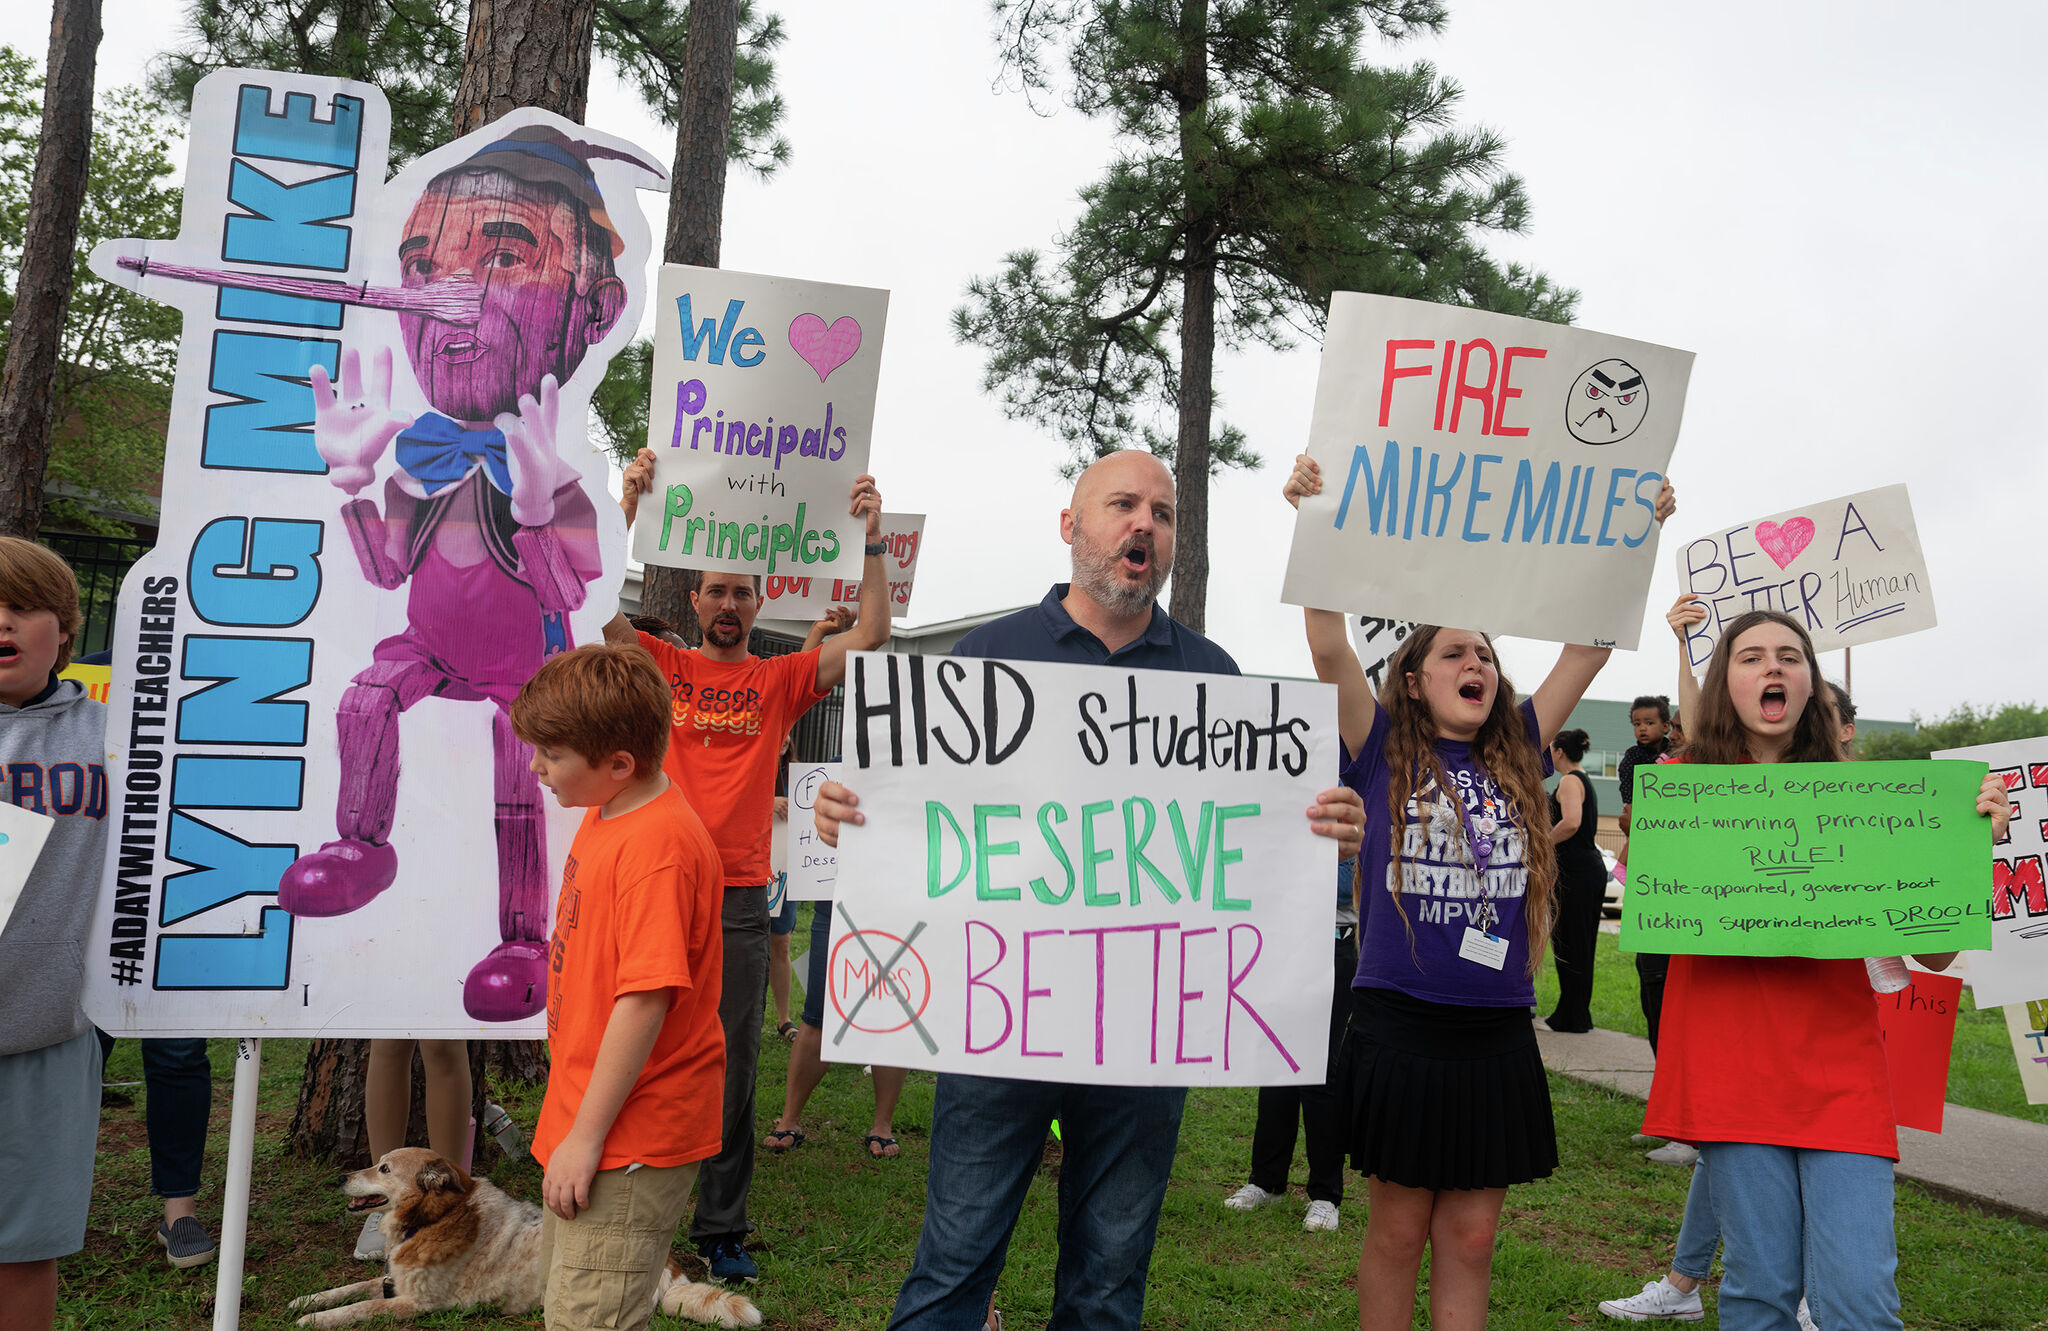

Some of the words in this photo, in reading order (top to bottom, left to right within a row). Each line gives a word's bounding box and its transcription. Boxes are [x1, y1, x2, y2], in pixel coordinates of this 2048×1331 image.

[201, 84, 365, 475] MIKE
[676, 293, 766, 367] We
[671, 379, 847, 470] Principals
[1378, 338, 1548, 436] FIRE
[659, 484, 840, 574] Principles
[727, 473, 785, 497] with
[1334, 440, 1503, 542] MIKE
[1501, 458, 1663, 548] MILES
[1687, 526, 1763, 595] BE
[1832, 502, 1885, 561] A
[1684, 572, 1823, 666] BETTER
[1829, 567, 1921, 620] Human
[153, 516, 324, 990] LYING
[854, 655, 1035, 769] HISD
[1077, 675, 1311, 776] students
[110, 575, 179, 986] #ADAYWITHOUTTEACHERS
[1639, 772, 1775, 803] Respected,
[1783, 777, 1938, 803] experienced,
[926, 796, 1261, 911] DESERVE
[1636, 815, 1799, 847] award-winning
[1817, 810, 1942, 834] principals
[1742, 845, 1845, 866] RULE!
[1419, 899, 1500, 925] MPVA
[1636, 874, 1795, 900] State-appointed,
[1802, 877, 1940, 902] governor-boot
[1638, 912, 1703, 936] licking
[1883, 899, 1993, 926] DROOL!
[964, 920, 1301, 1073] BETTER
